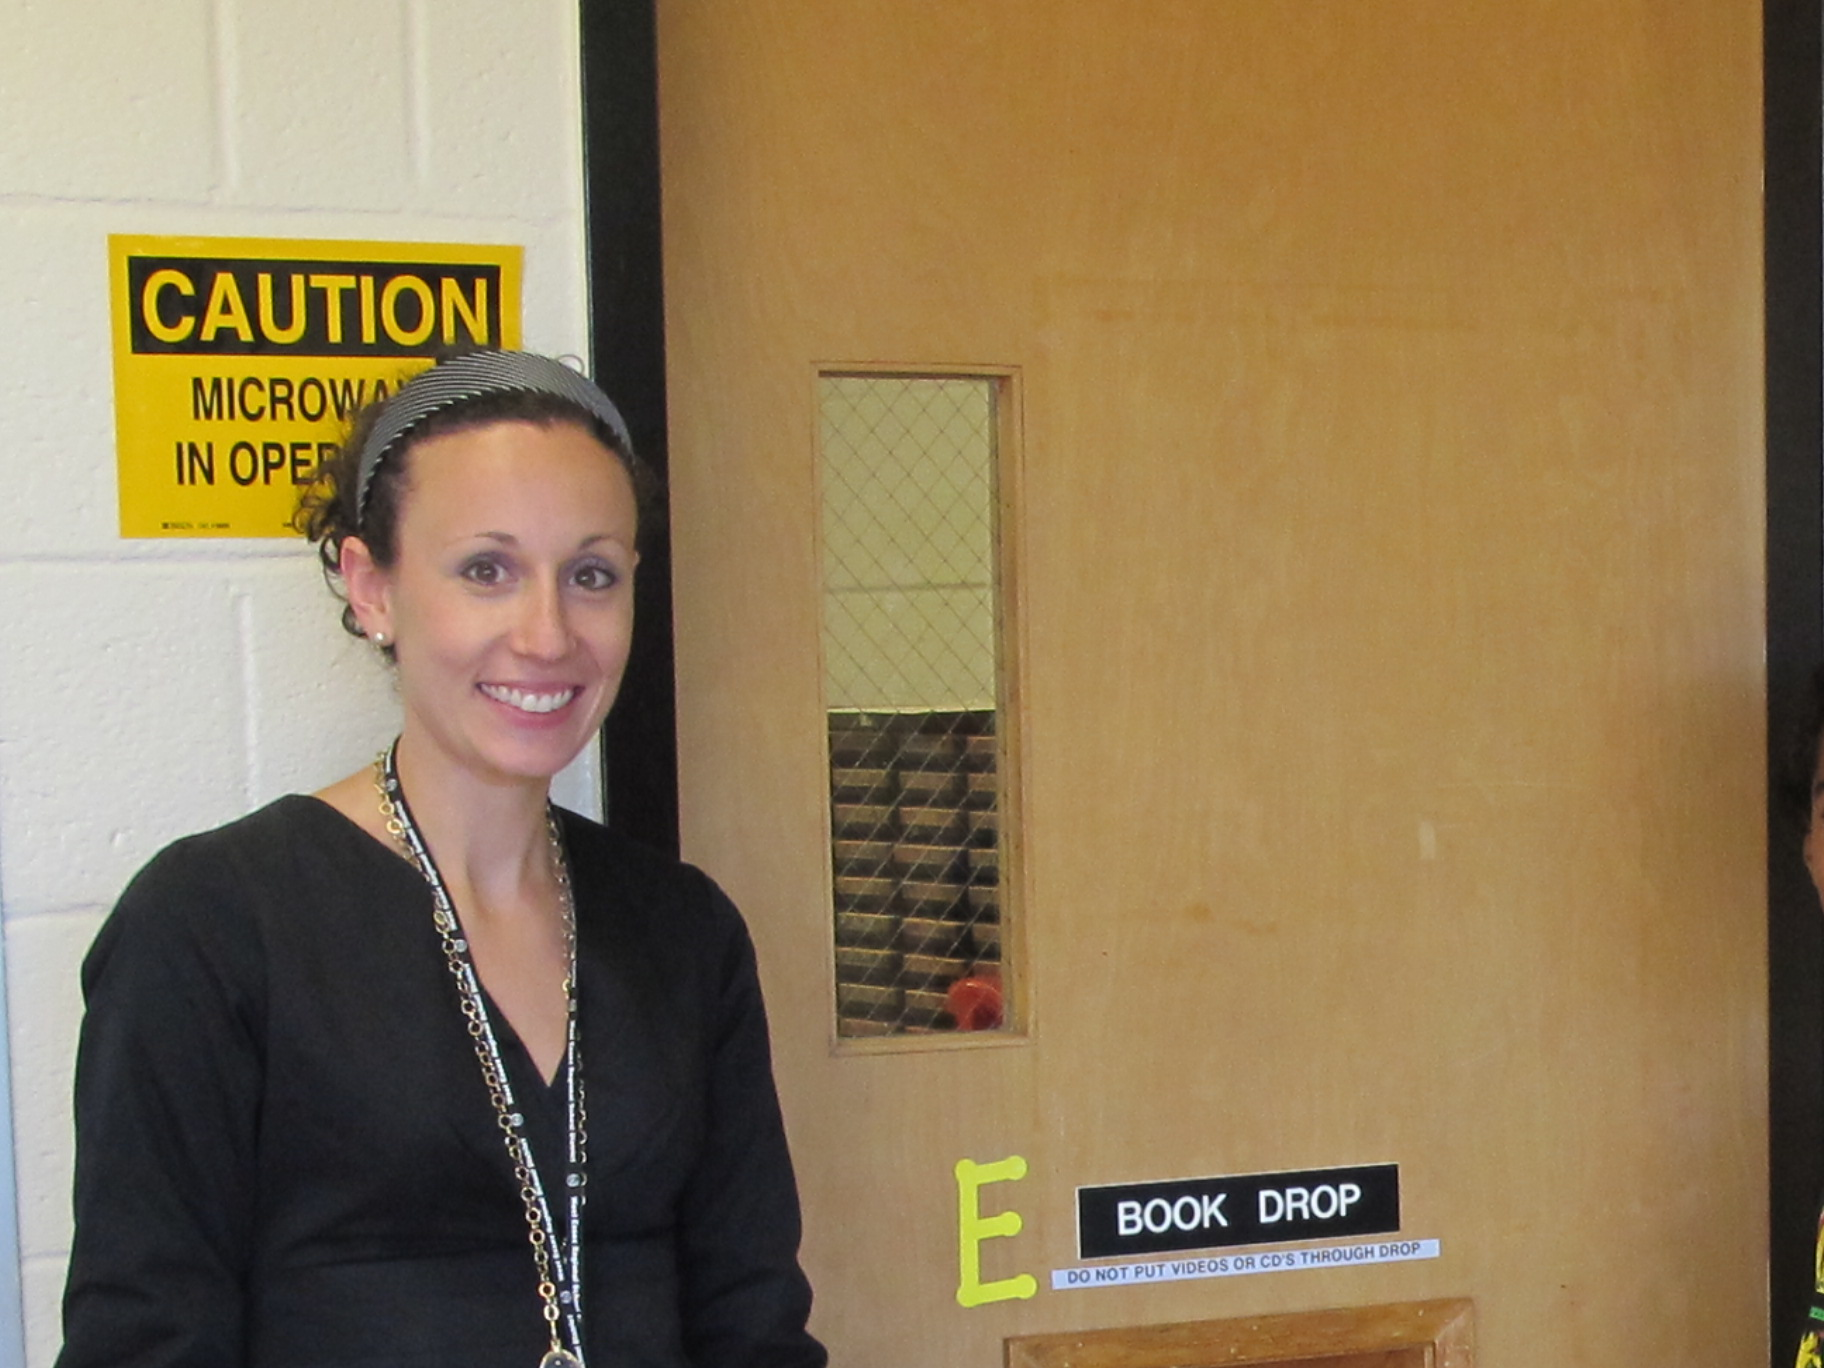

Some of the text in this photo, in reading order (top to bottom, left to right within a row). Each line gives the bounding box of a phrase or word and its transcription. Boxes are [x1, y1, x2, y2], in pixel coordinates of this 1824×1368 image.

[142, 268, 489, 347] CAUTION
[192, 376, 404, 422] MICROWA
[176, 442, 214, 485] IN
[954, 1155, 1037, 1308] E
[1117, 1183, 1362, 1236] BOOK DROP
[1067, 1242, 1421, 1284] DO NOT PUT VIDEOS OR CD'S THROUGH DROP
